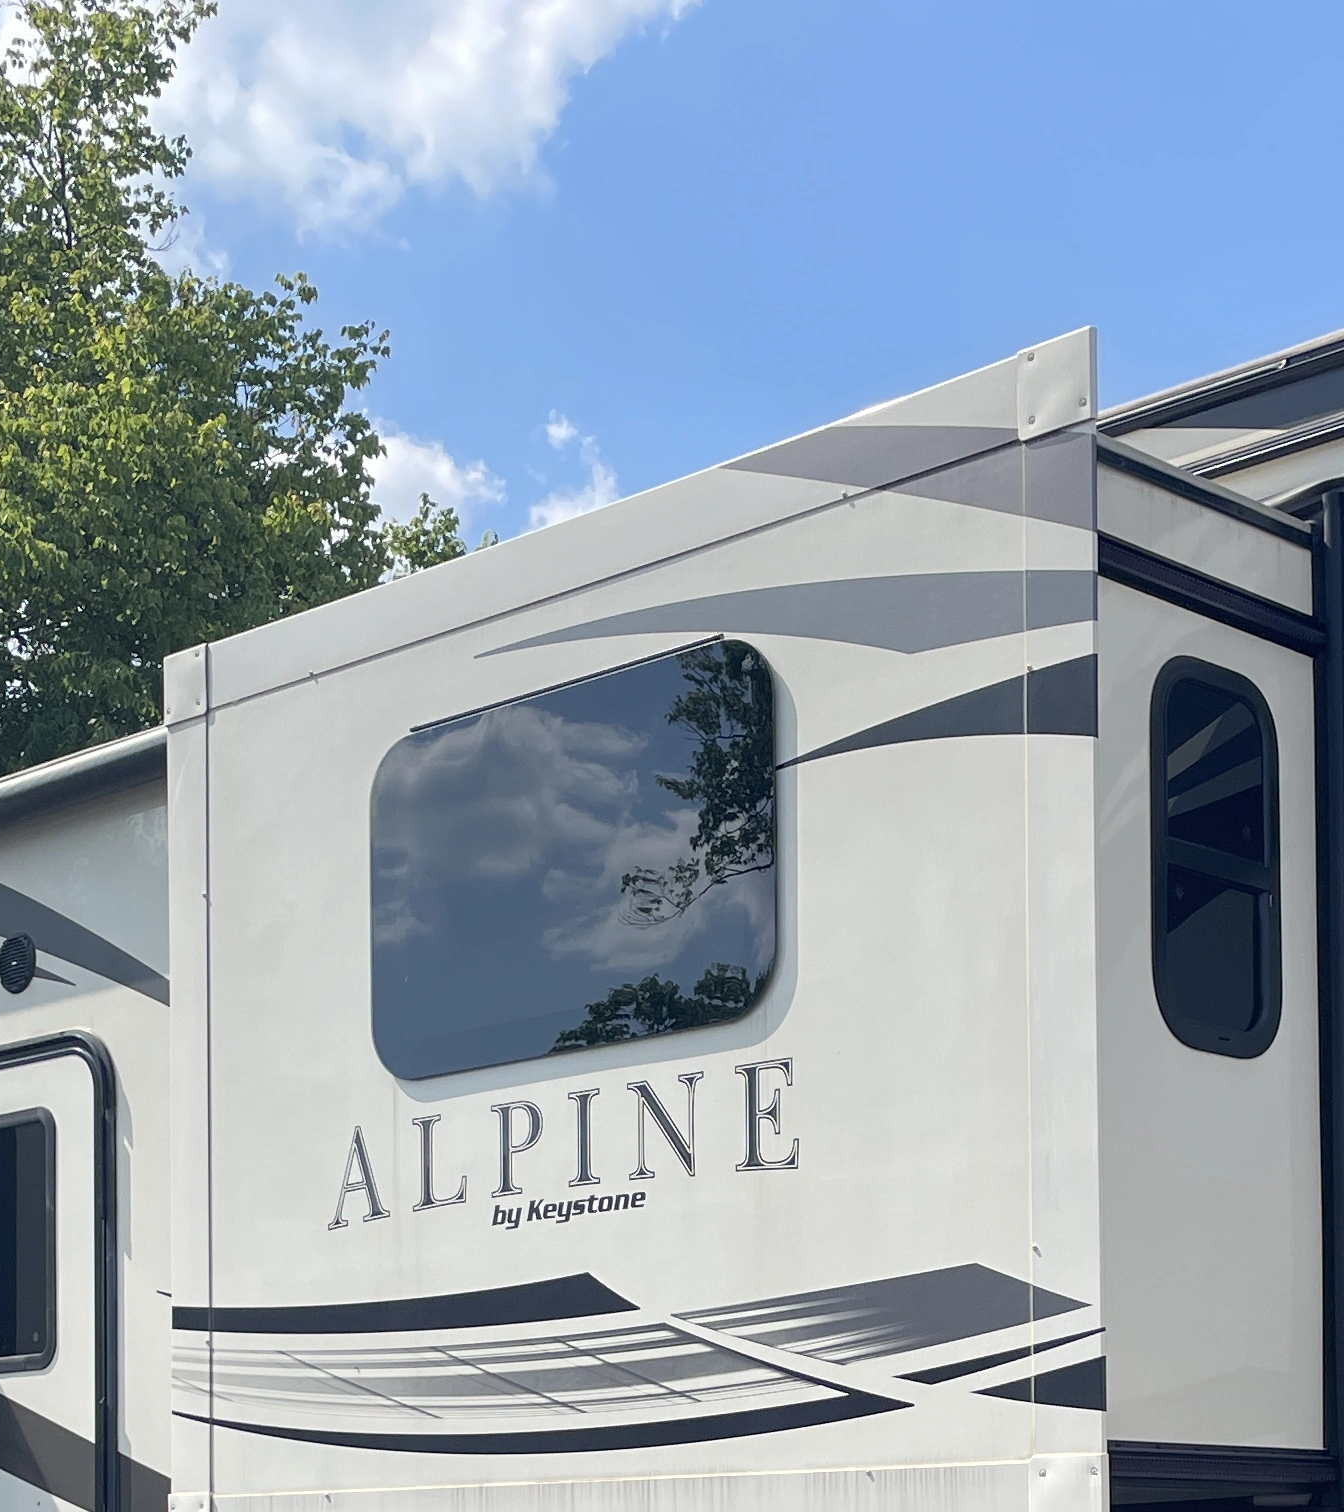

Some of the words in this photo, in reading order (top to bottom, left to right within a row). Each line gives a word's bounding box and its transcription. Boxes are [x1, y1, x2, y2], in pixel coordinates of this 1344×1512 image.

[327, 1057, 800, 1231] ALPINE
[491, 1204, 522, 1230] by
[525, 1189, 648, 1224] Keystone
